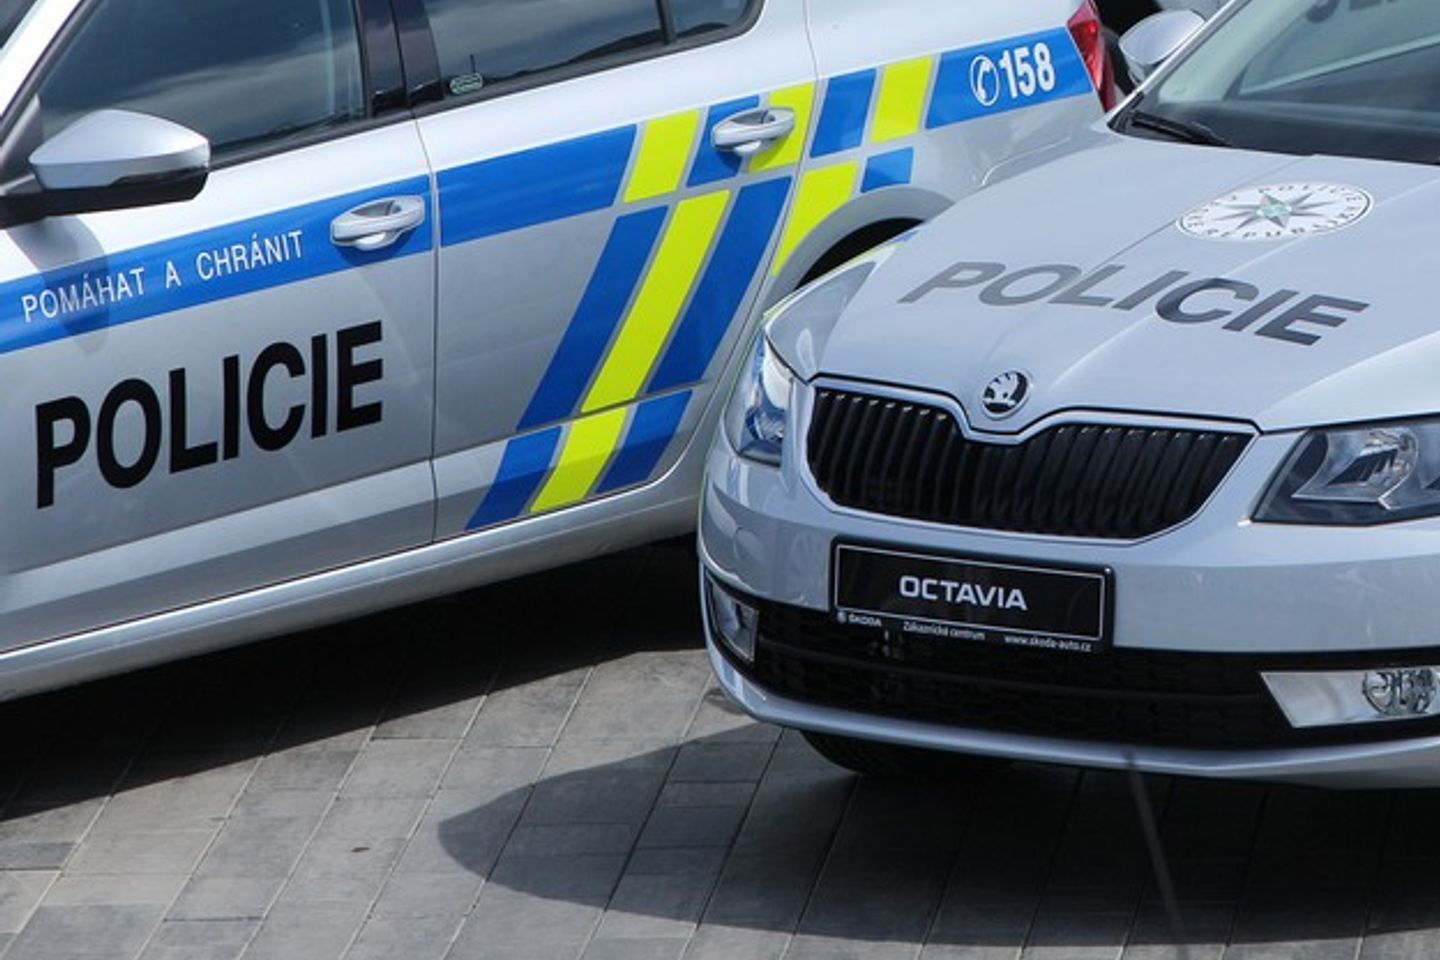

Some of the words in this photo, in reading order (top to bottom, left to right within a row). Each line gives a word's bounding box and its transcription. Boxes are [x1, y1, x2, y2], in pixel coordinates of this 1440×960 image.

[999, 42, 1055, 100] 158
[21, 266, 145, 323] POMÁHAT
[165, 260, 181, 289] A
[195, 230, 303, 281] CHRÁNIT
[896, 261, 1371, 346] POLICIE
[35, 319, 383, 509] POLICIE
[899, 575, 1029, 611] OCTAVIA
